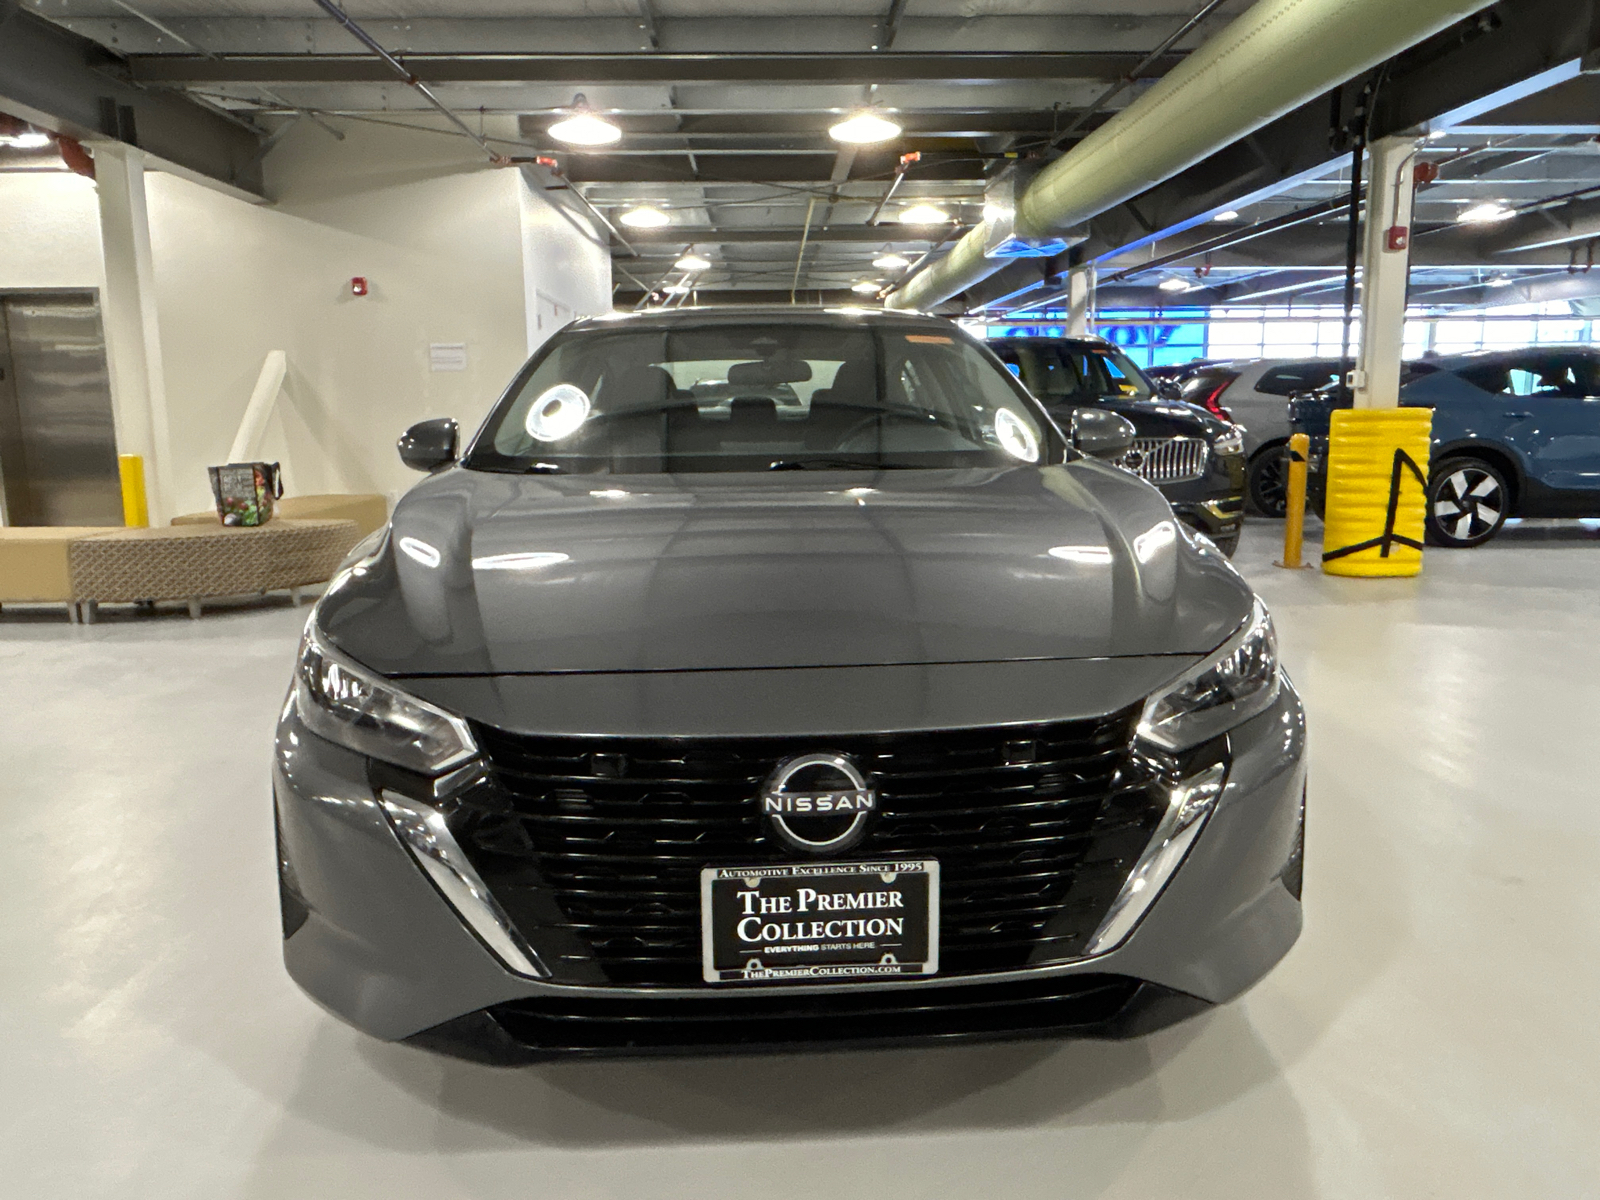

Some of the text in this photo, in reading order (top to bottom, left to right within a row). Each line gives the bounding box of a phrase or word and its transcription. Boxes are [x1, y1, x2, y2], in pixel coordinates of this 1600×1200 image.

[765, 794, 873, 812] NISSAN
[893, 863, 922, 872] 1995
[737, 888, 904, 914] THE PREMIER
[736, 917, 904, 942] COLLECTION
[764, 941, 876, 954] EVERYTHING STARTS HERE
